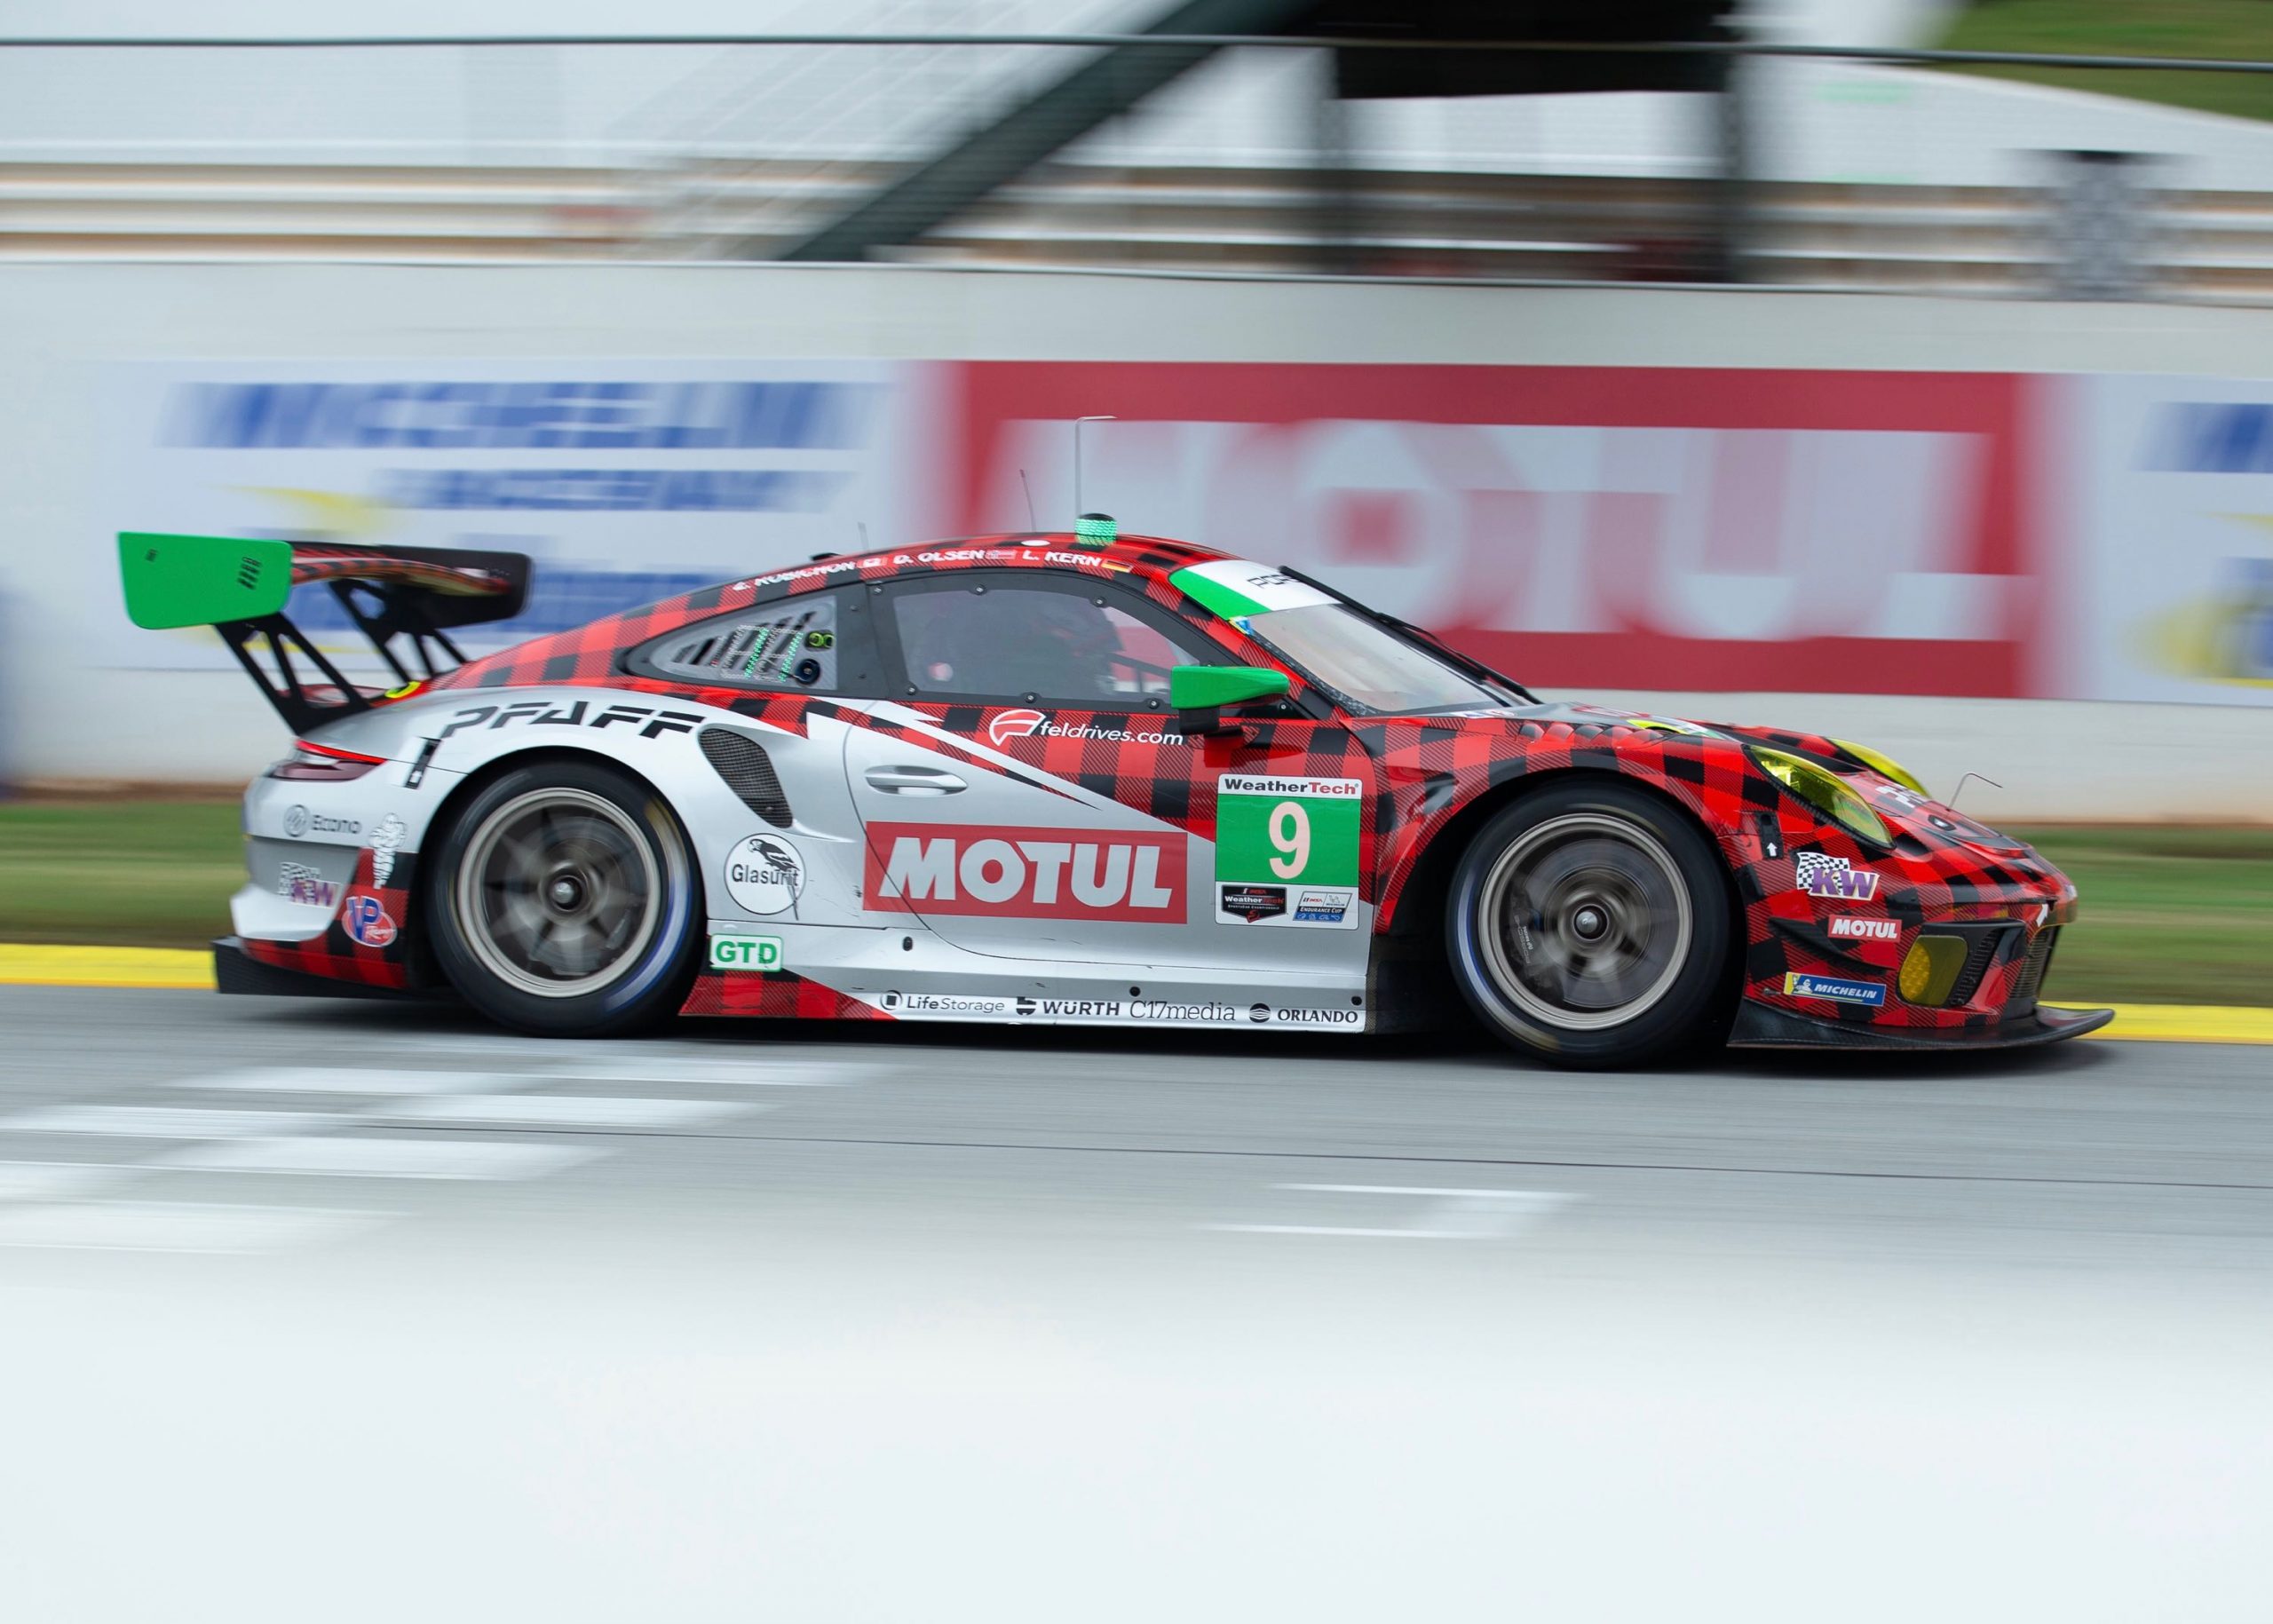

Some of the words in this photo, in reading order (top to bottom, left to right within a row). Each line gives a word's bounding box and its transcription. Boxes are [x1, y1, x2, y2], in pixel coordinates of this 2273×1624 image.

[918, 549, 986, 563] OLSEN
[1022, 550, 1041, 561] L.
[1044, 551, 1102, 567] KERN
[439, 700, 707, 741] PFAFF
[1040, 721, 1184, 746] feldrives.com
[1224, 778, 1357, 795] WeatherTech
[313, 814, 362, 835] Econo
[1268, 801, 1311, 880] 9
[732, 863, 799, 887] Glasurit
[877, 836, 1173, 909] MOTUL
[1810, 867, 1876, 899] KW
[1831, 918, 1898, 939] MOTUL
[716, 940, 778, 965] GTD
[1814, 983, 1878, 1000] MICHELIN
[1042, 1000, 1121, 1016] WÜRTH
[1129, 1000, 1236, 1021] C17media
[1277, 1009, 1358, 1024] ORLANDO
